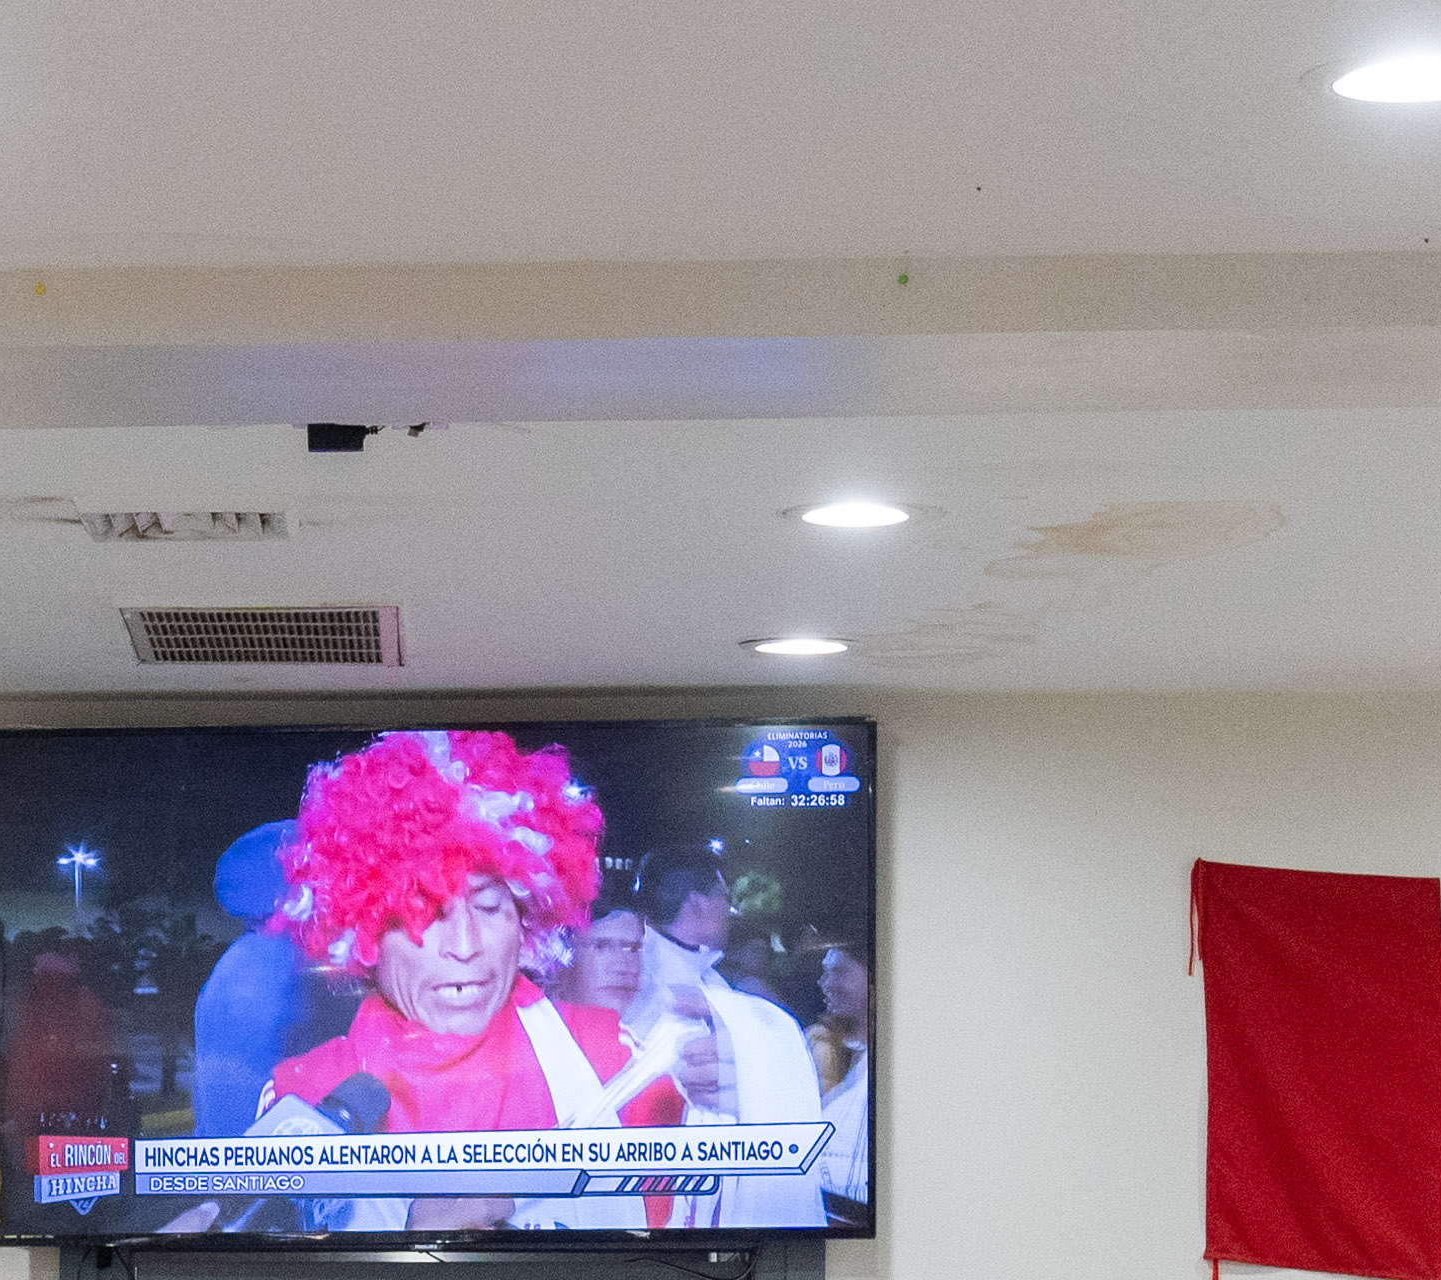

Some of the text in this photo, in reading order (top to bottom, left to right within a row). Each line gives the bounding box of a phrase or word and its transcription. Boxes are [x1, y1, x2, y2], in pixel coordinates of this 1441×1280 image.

[767, 731, 828, 741] ELIMINATORIAS
[788, 740, 808, 749] 2026
[788, 756, 808, 770] VS
[750, 794, 845, 806] Faltan: 32:26:58
[50, 1153, 60, 1167] EL
[63, 1140, 112, 1167] RINCÓN
[144, 1138, 783, 1167] HINCHAS PERUANOS ALENTARON A LA SELECCIÓN EN SU ARRIBO A SANTIAGO
[48, 1174, 117, 1197] HINCHA
[150, 1175, 304, 1191] DESDE SANTIAGO
